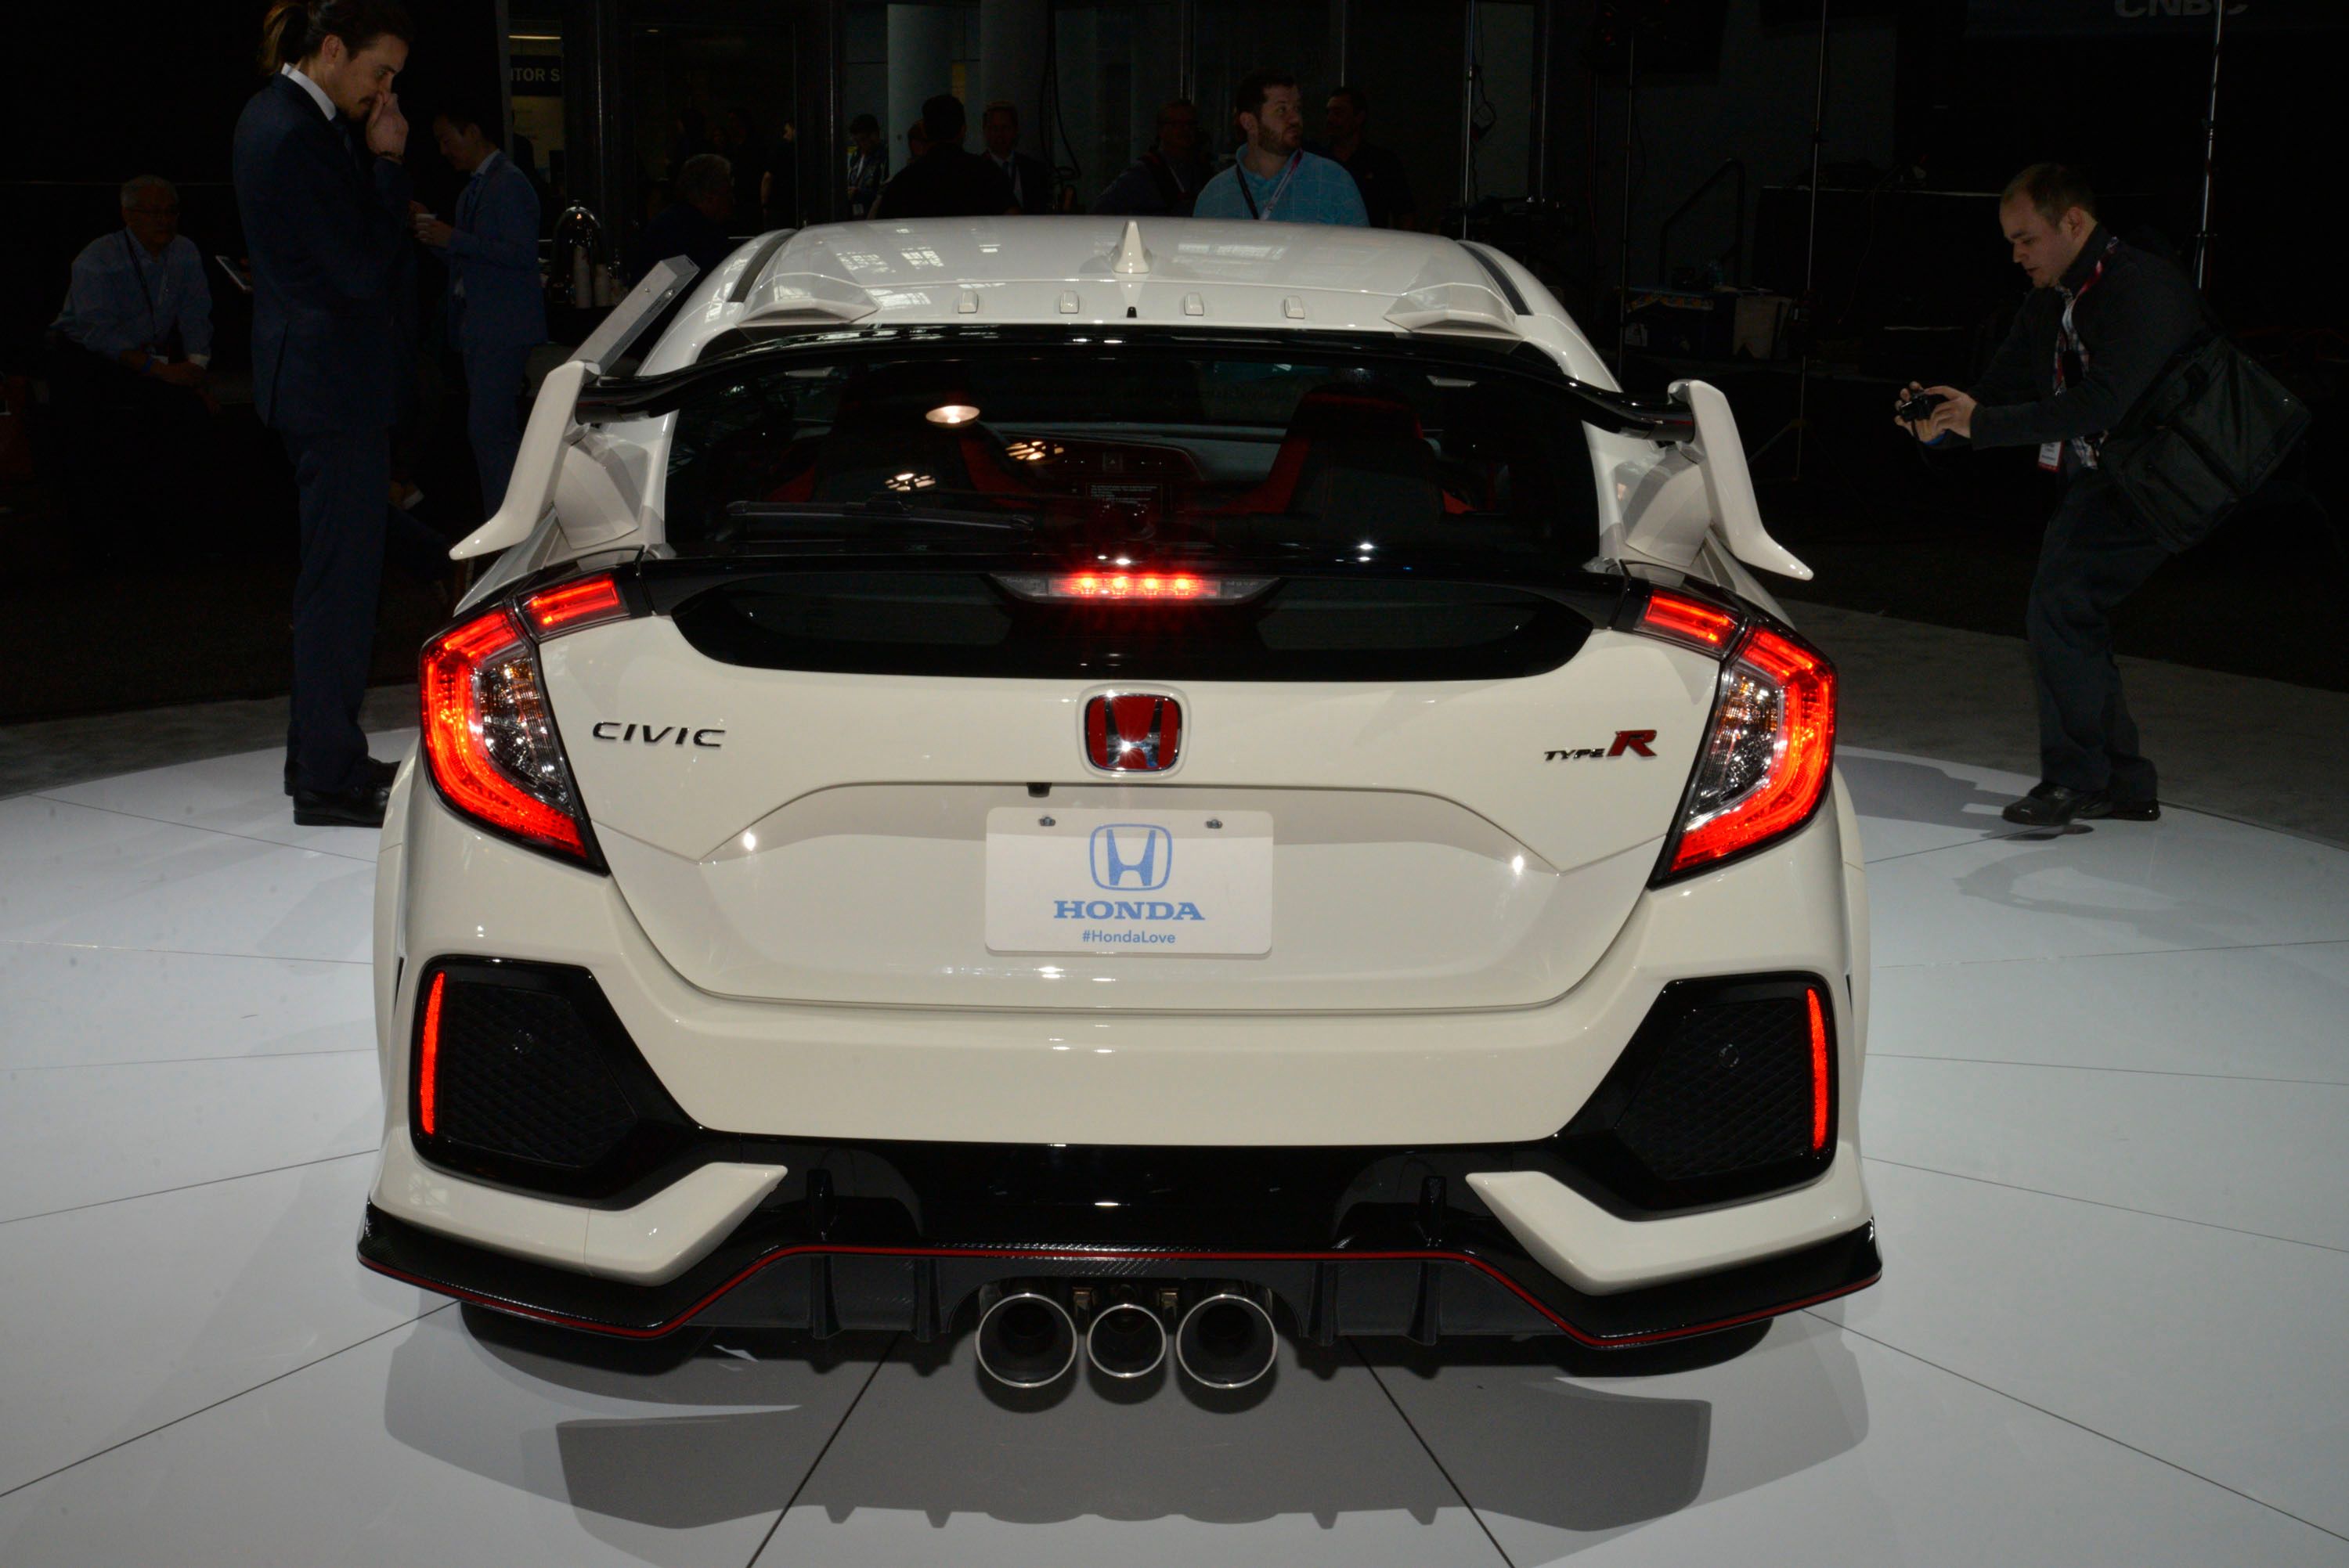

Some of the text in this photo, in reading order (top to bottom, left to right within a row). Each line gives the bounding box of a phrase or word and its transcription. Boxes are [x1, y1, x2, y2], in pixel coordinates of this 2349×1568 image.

[593, 722, 727, 748] CIVIC
[1544, 729, 1658, 762] TYPE R
[1053, 900, 1206, 921] HONDA
[1082, 929, 1176, 945] #HondaLove
